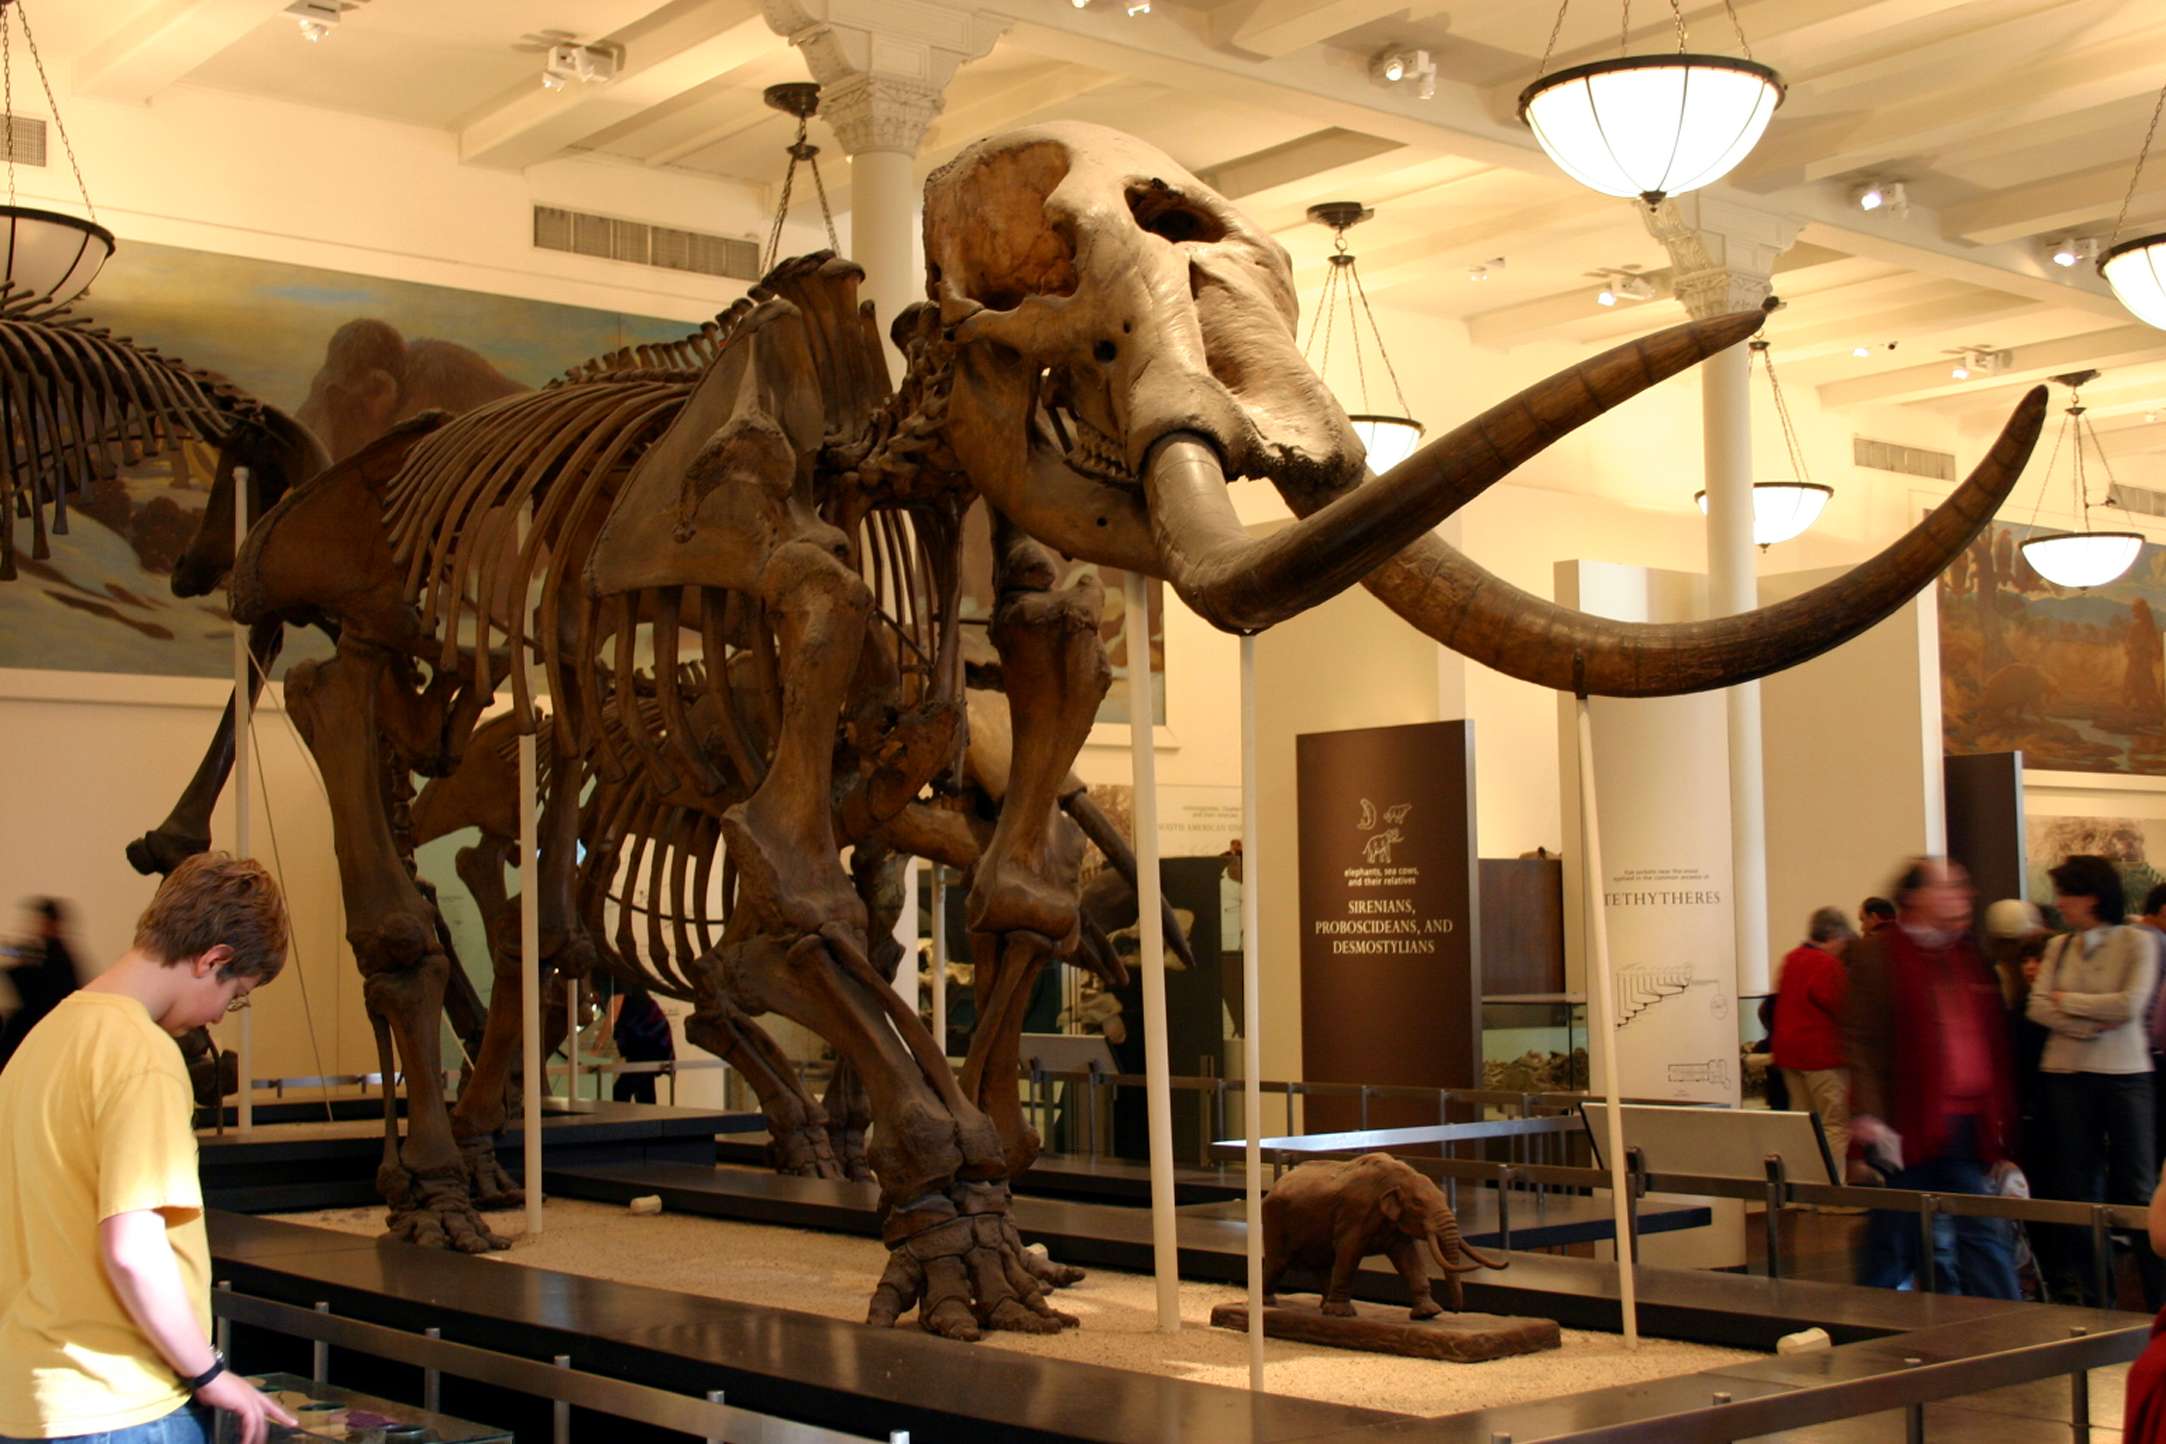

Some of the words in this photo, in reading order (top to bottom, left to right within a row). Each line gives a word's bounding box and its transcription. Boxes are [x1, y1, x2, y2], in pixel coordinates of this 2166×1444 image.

[1348, 877, 1362, 887] and
[1364, 877, 1382, 886] their
[1383, 876, 1417, 886] relatives
[1348, 899, 1416, 915] SIRENIANS,
[1604, 891, 1720, 907] TETHYTHERES
[1315, 919, 1421, 935] PROBOSCIDEANS,
[1424, 918, 1453, 934] AND
[1333, 938, 1435, 955] DESMOSTYLIANS
